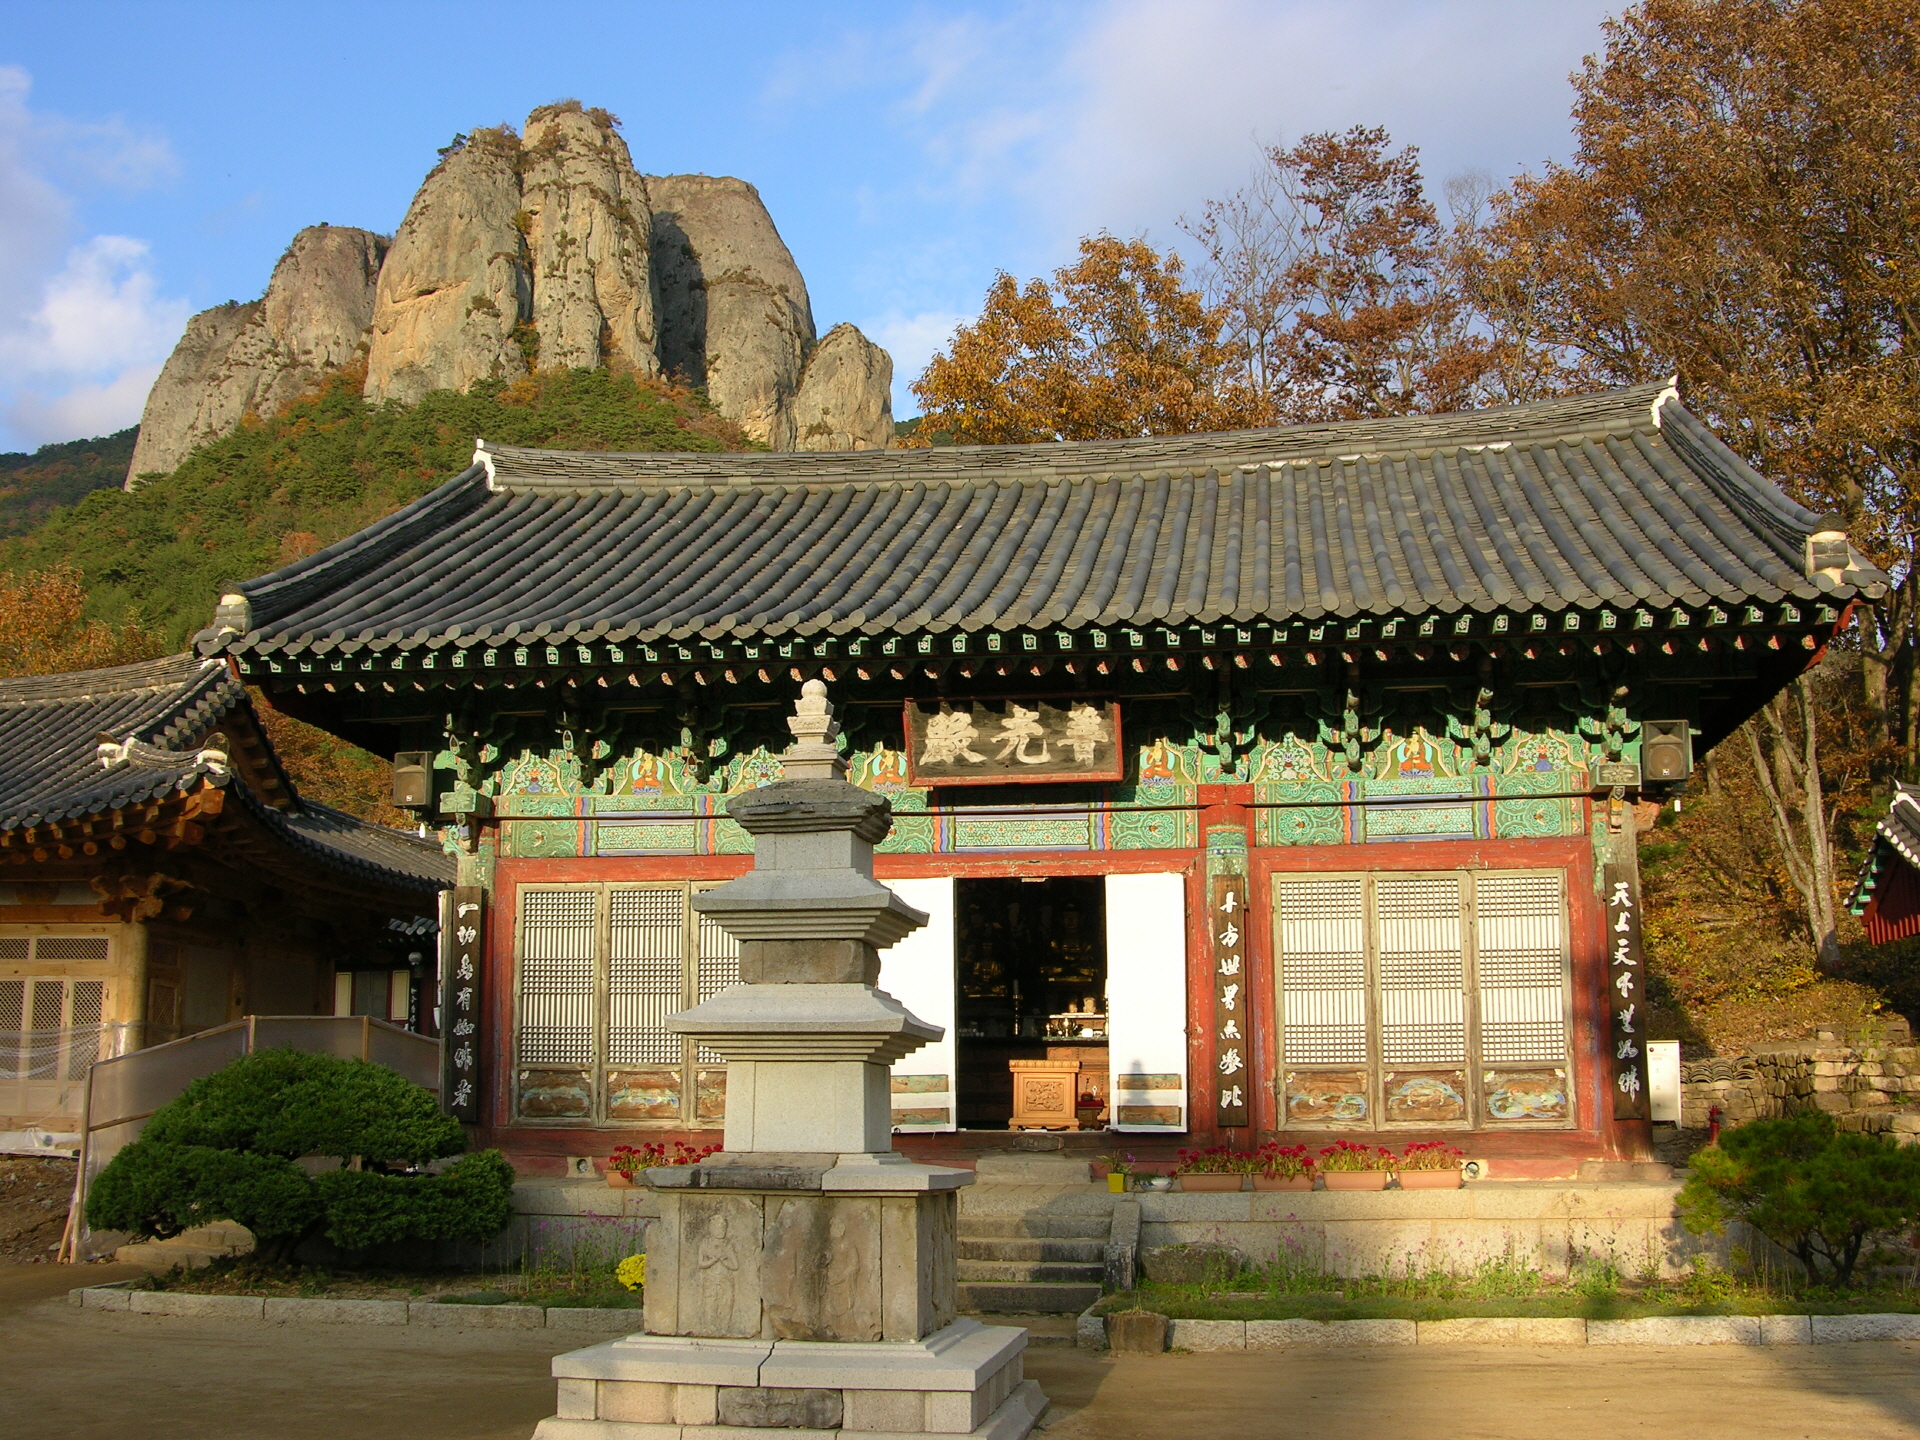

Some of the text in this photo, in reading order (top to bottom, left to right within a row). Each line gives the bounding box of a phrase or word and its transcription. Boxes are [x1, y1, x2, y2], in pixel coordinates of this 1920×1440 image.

[919, 704, 1109, 768] 普光殿
[452, 902, 479, 1107] 一切無有如佛者
[1609, 881, 1641, 1103] 天上天下無如佛
